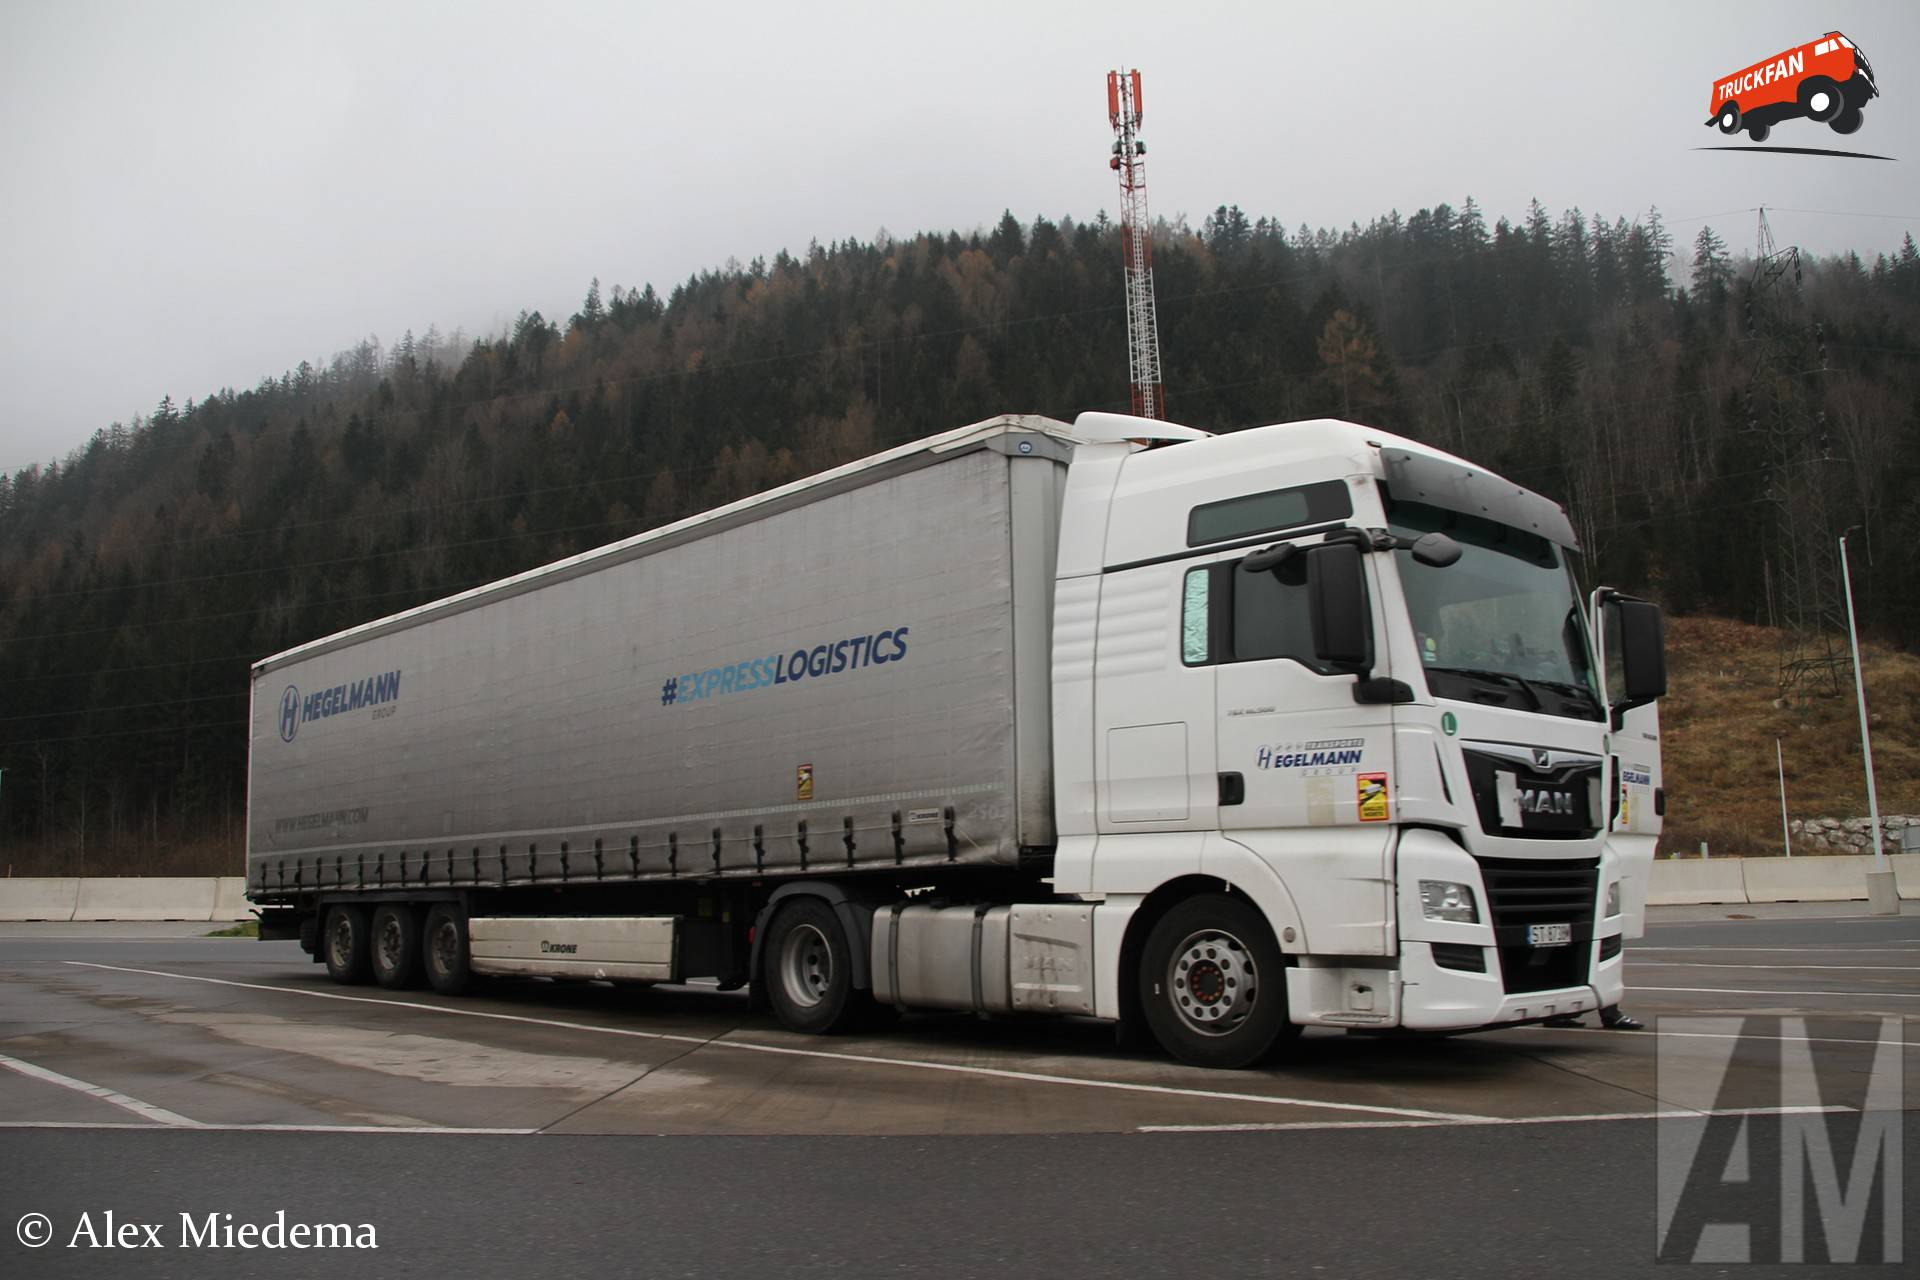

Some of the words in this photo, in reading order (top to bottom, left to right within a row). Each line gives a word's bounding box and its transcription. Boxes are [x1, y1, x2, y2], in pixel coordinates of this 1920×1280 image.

[661, 627, 909, 706] #EXPRESSLOGISTICS
[301, 670, 402, 723] HEGELMANN
[371, 706, 397, 721] GROUP
[1444, 715, 1454, 734] L
[1305, 738, 1365, 751] TRANSPORTE
[1517, 788, 1574, 815] MAN
[1532, 926, 1545, 943] ST
[549, 943, 577, 954] KRONE
